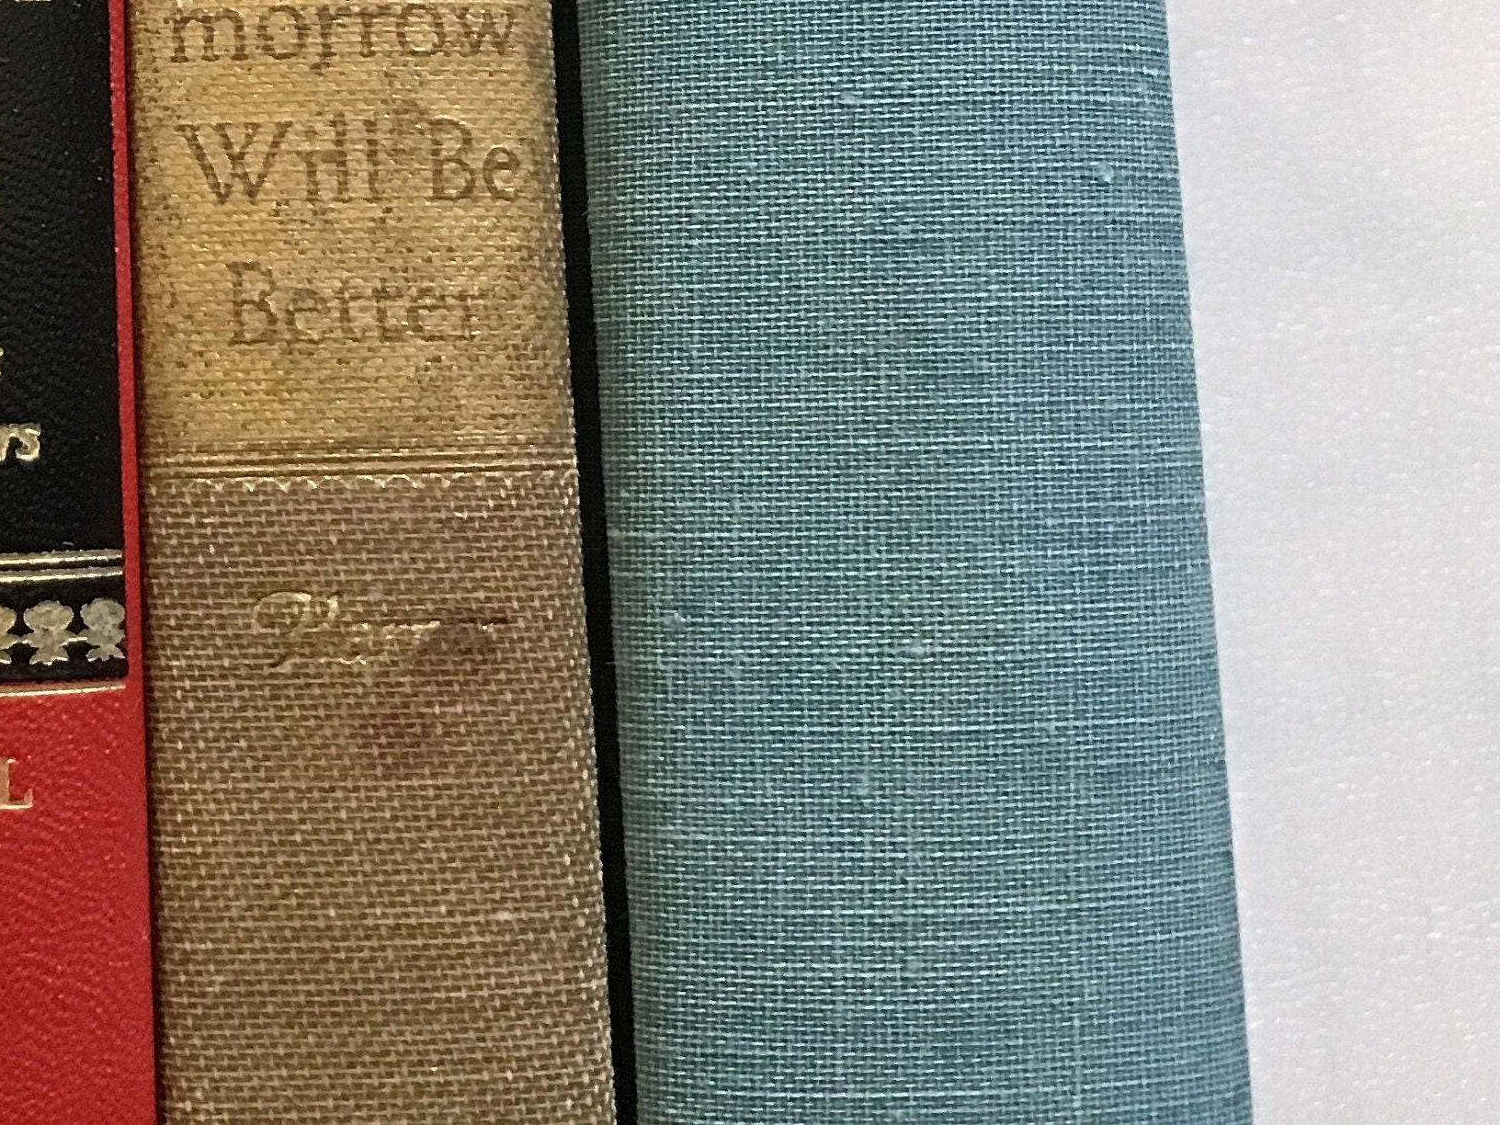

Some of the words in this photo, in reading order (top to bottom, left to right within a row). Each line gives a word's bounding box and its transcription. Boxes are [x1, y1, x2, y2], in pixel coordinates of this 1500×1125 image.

[163, 2, 516, 65] morrow
[178, 111, 393, 205] Will
[426, 117, 522, 202] Be
[226, 260, 485, 347] Better
